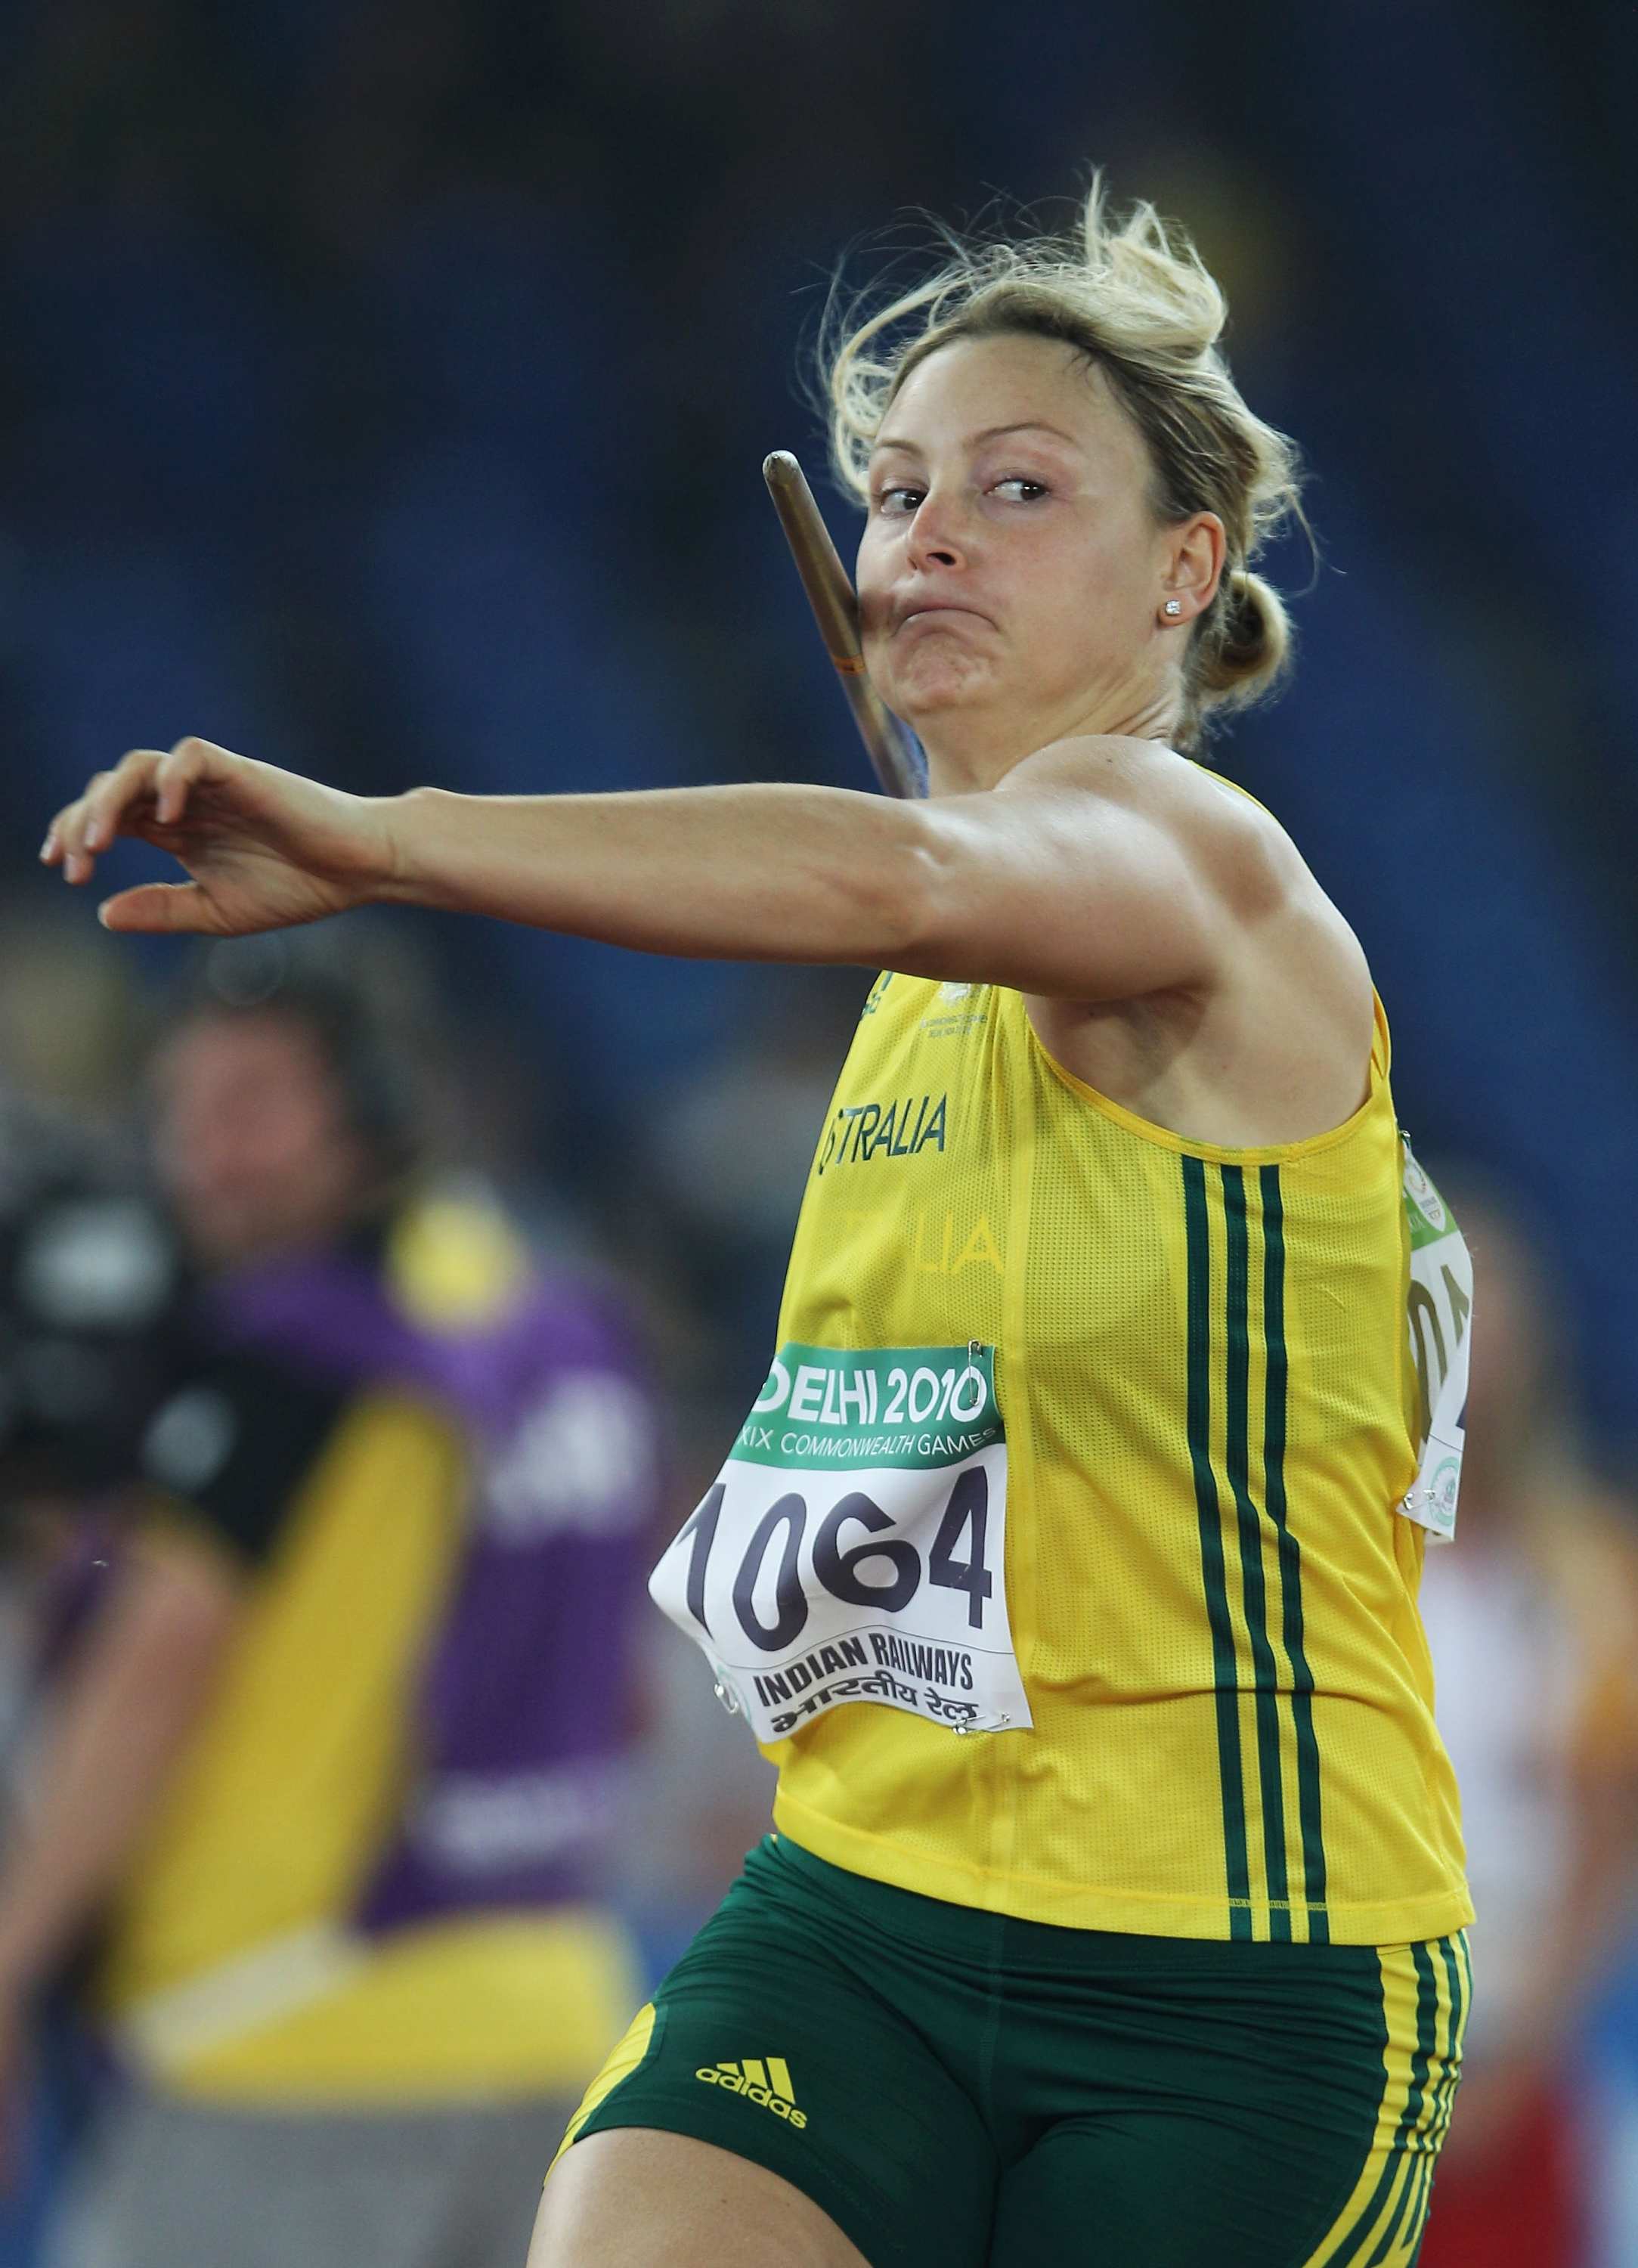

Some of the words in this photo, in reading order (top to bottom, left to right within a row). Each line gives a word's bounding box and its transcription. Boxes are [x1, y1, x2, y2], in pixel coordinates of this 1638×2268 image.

[751, 1358, 878, 1425] DELHI
[883, 1365, 987, 1423] 2010
[780, 1432, 913, 1458] COMMONWEALTH
[917, 1427, 995, 1456] GAMES
[675, 1464, 992, 1652] 1064
[753, 1636, 869, 1706] INDIAN
[869, 1632, 974, 1690] RAILWAYS
[770, 1668, 918, 1733] भारतीय
[695, 2068, 807, 2129] adidas
